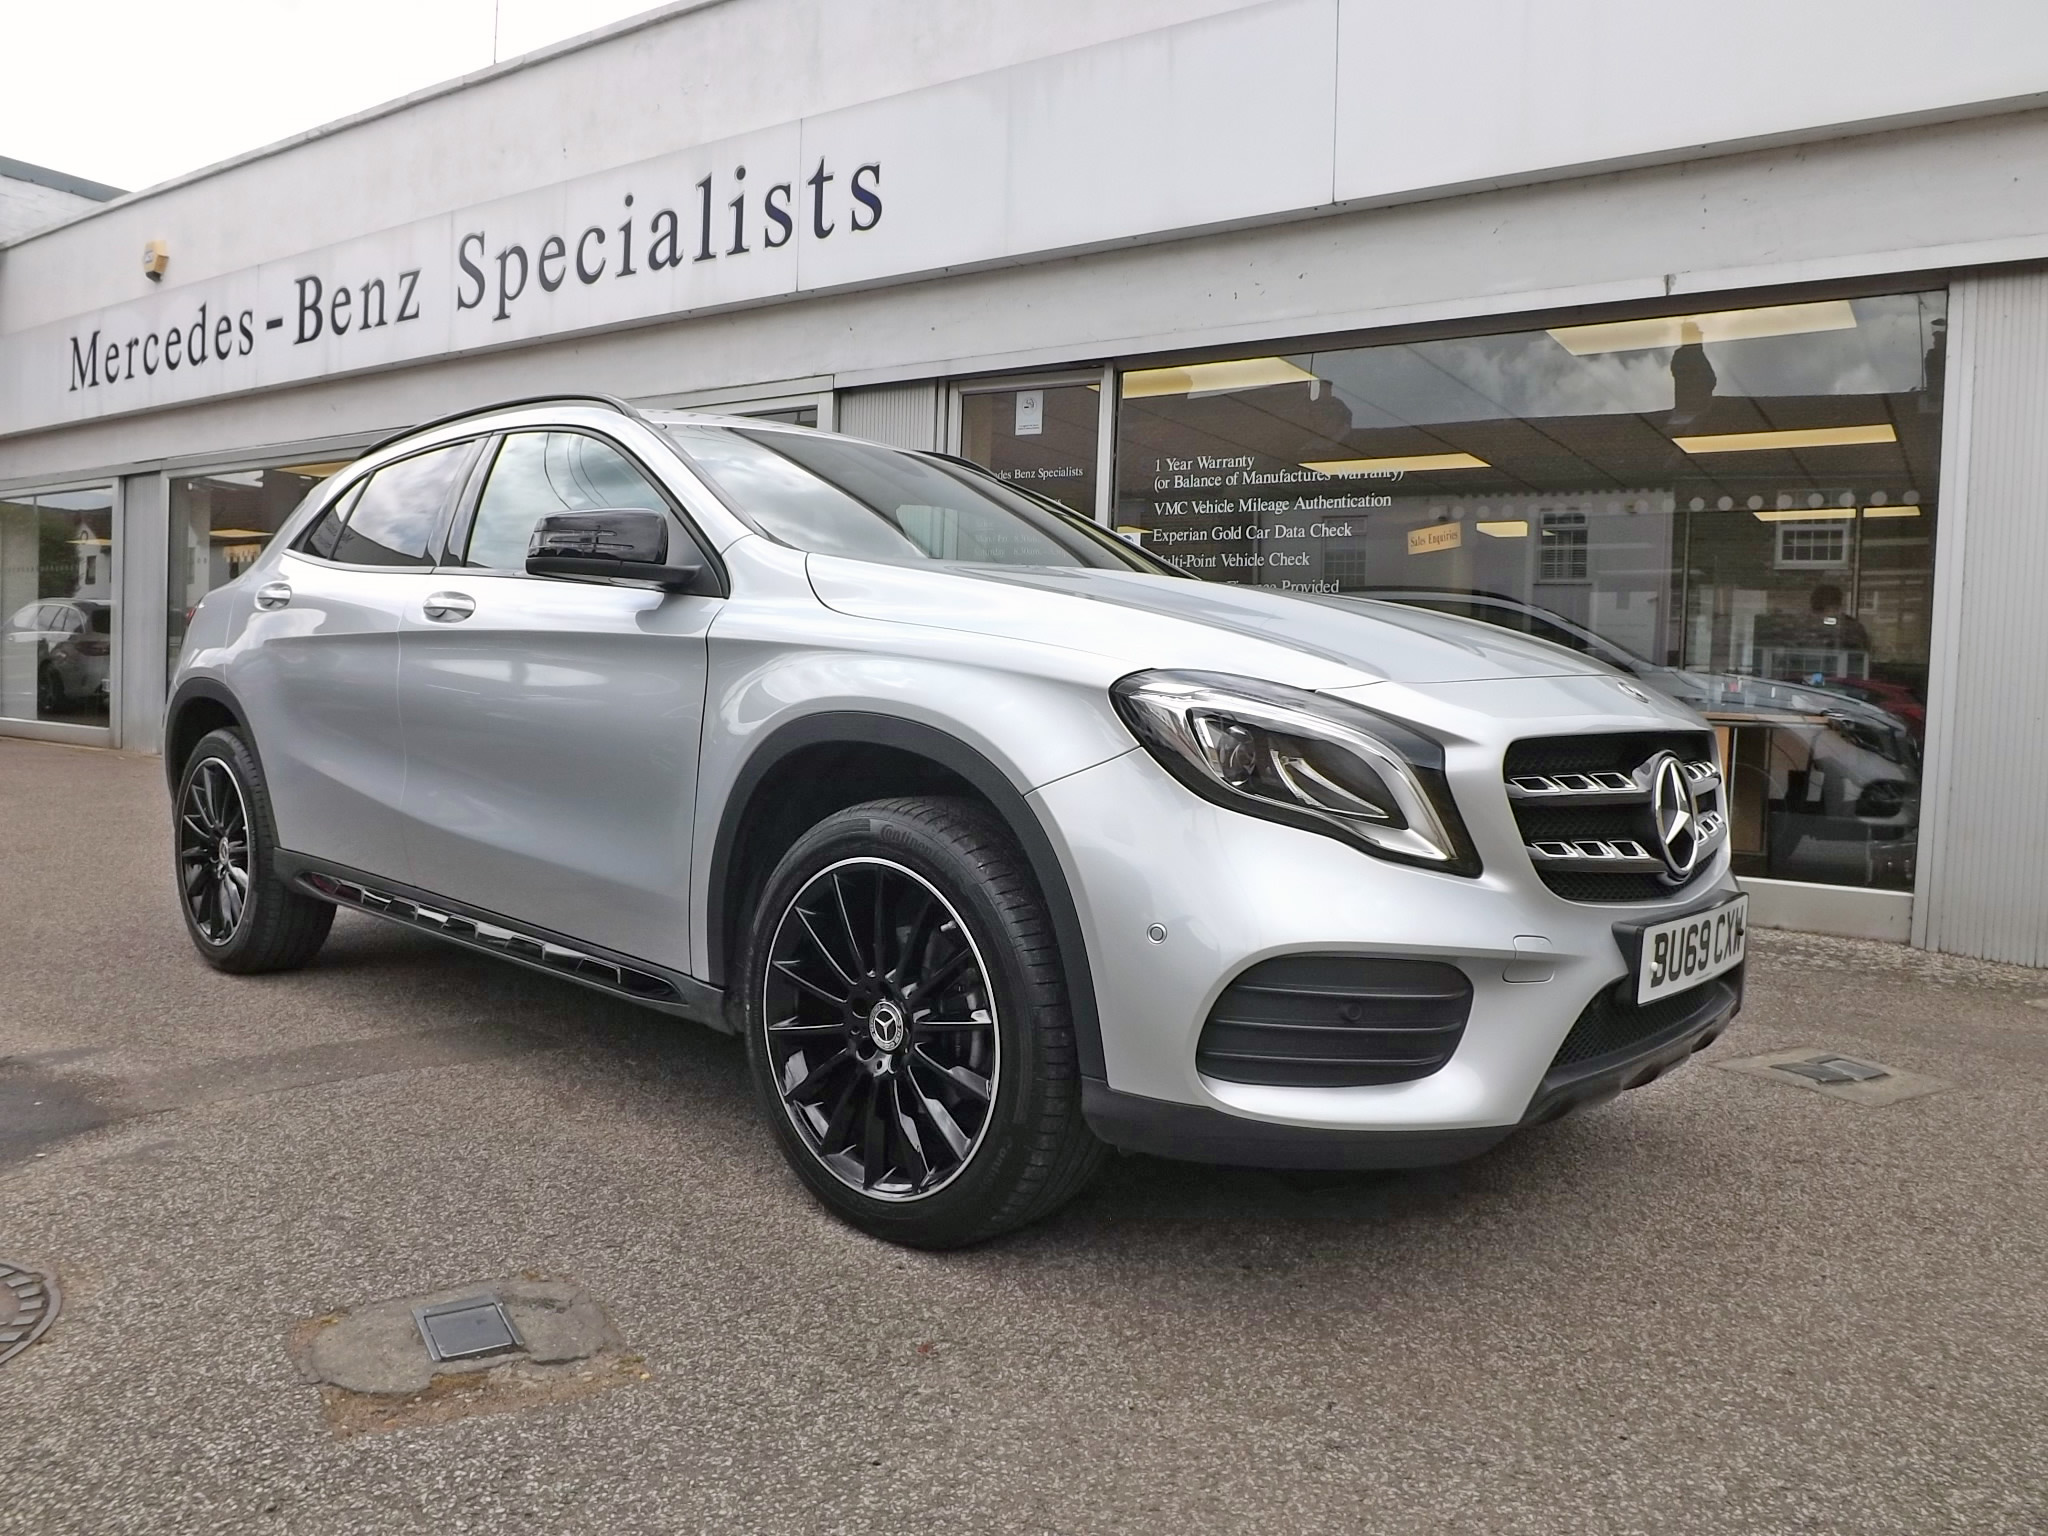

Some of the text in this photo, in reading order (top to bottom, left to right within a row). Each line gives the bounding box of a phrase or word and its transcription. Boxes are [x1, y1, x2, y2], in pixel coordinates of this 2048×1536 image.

[69, 156, 883, 391] Mercedes-Benz Specialists
[1014, 469, 1036, 479] Benz
[1037, 466, 1083, 480] Specialists
[1155, 455, 1255, 472] 1 Year Warranty
[1154, 476, 1170, 493] (or
[1174, 474, 1221, 488] Balance
[1225, 472, 1239, 485] of
[1242, 468, 1331, 485] Manufactures
[1154, 492, 1392, 516] VMC Vehicle Mileage Authentication
[1153, 522, 1353, 545] Experian Gold Car Data Check
[1160, 552, 1310, 568] lti-Point Vehicle Check
[1281, 579, 1340, 593] Provided
[1651, 920, 1711, 988] BU69
